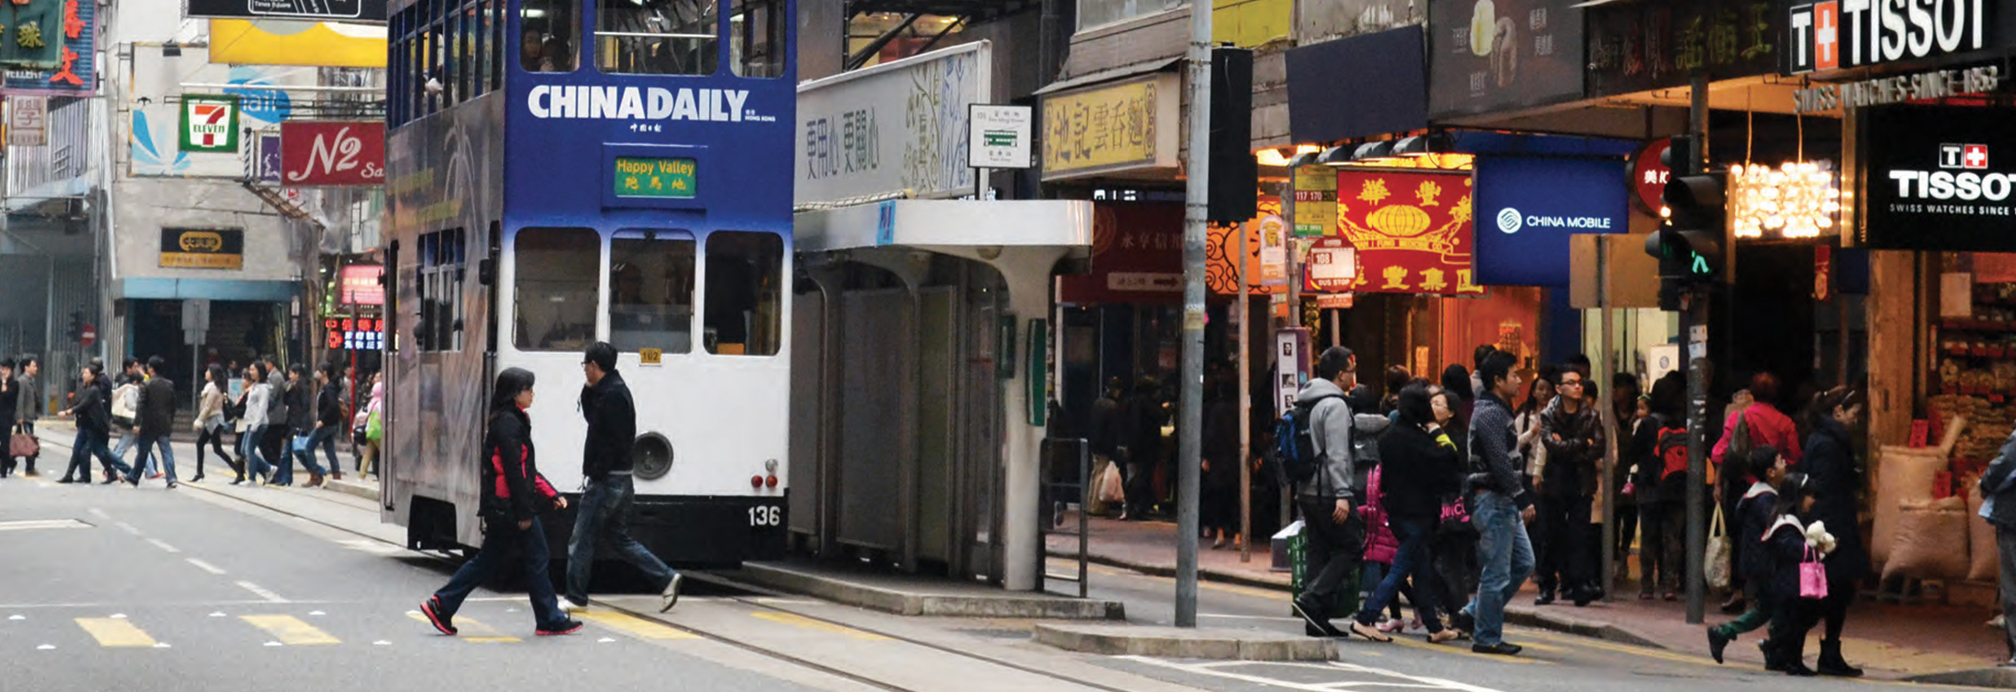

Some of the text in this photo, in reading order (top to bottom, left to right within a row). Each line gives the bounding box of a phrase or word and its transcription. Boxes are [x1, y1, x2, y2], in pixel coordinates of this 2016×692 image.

[1843, 0, 1983, 65] TISSOT
[1793, 85, 1837, 114] SWISS
[1840, 74, 1908, 109] WATCHES
[1911, 70, 1959, 100] SINCE
[617, 159, 694, 177] Happy Valley
[1295, 191, 1307, 201] 117
[1889, 203, 2009, 215] SWISS WATCHES SINCE
[1526, 215, 1611, 229] CHINA MOBILE
[642, 353, 659, 361] 102
[748, 505, 781, 526] 136
